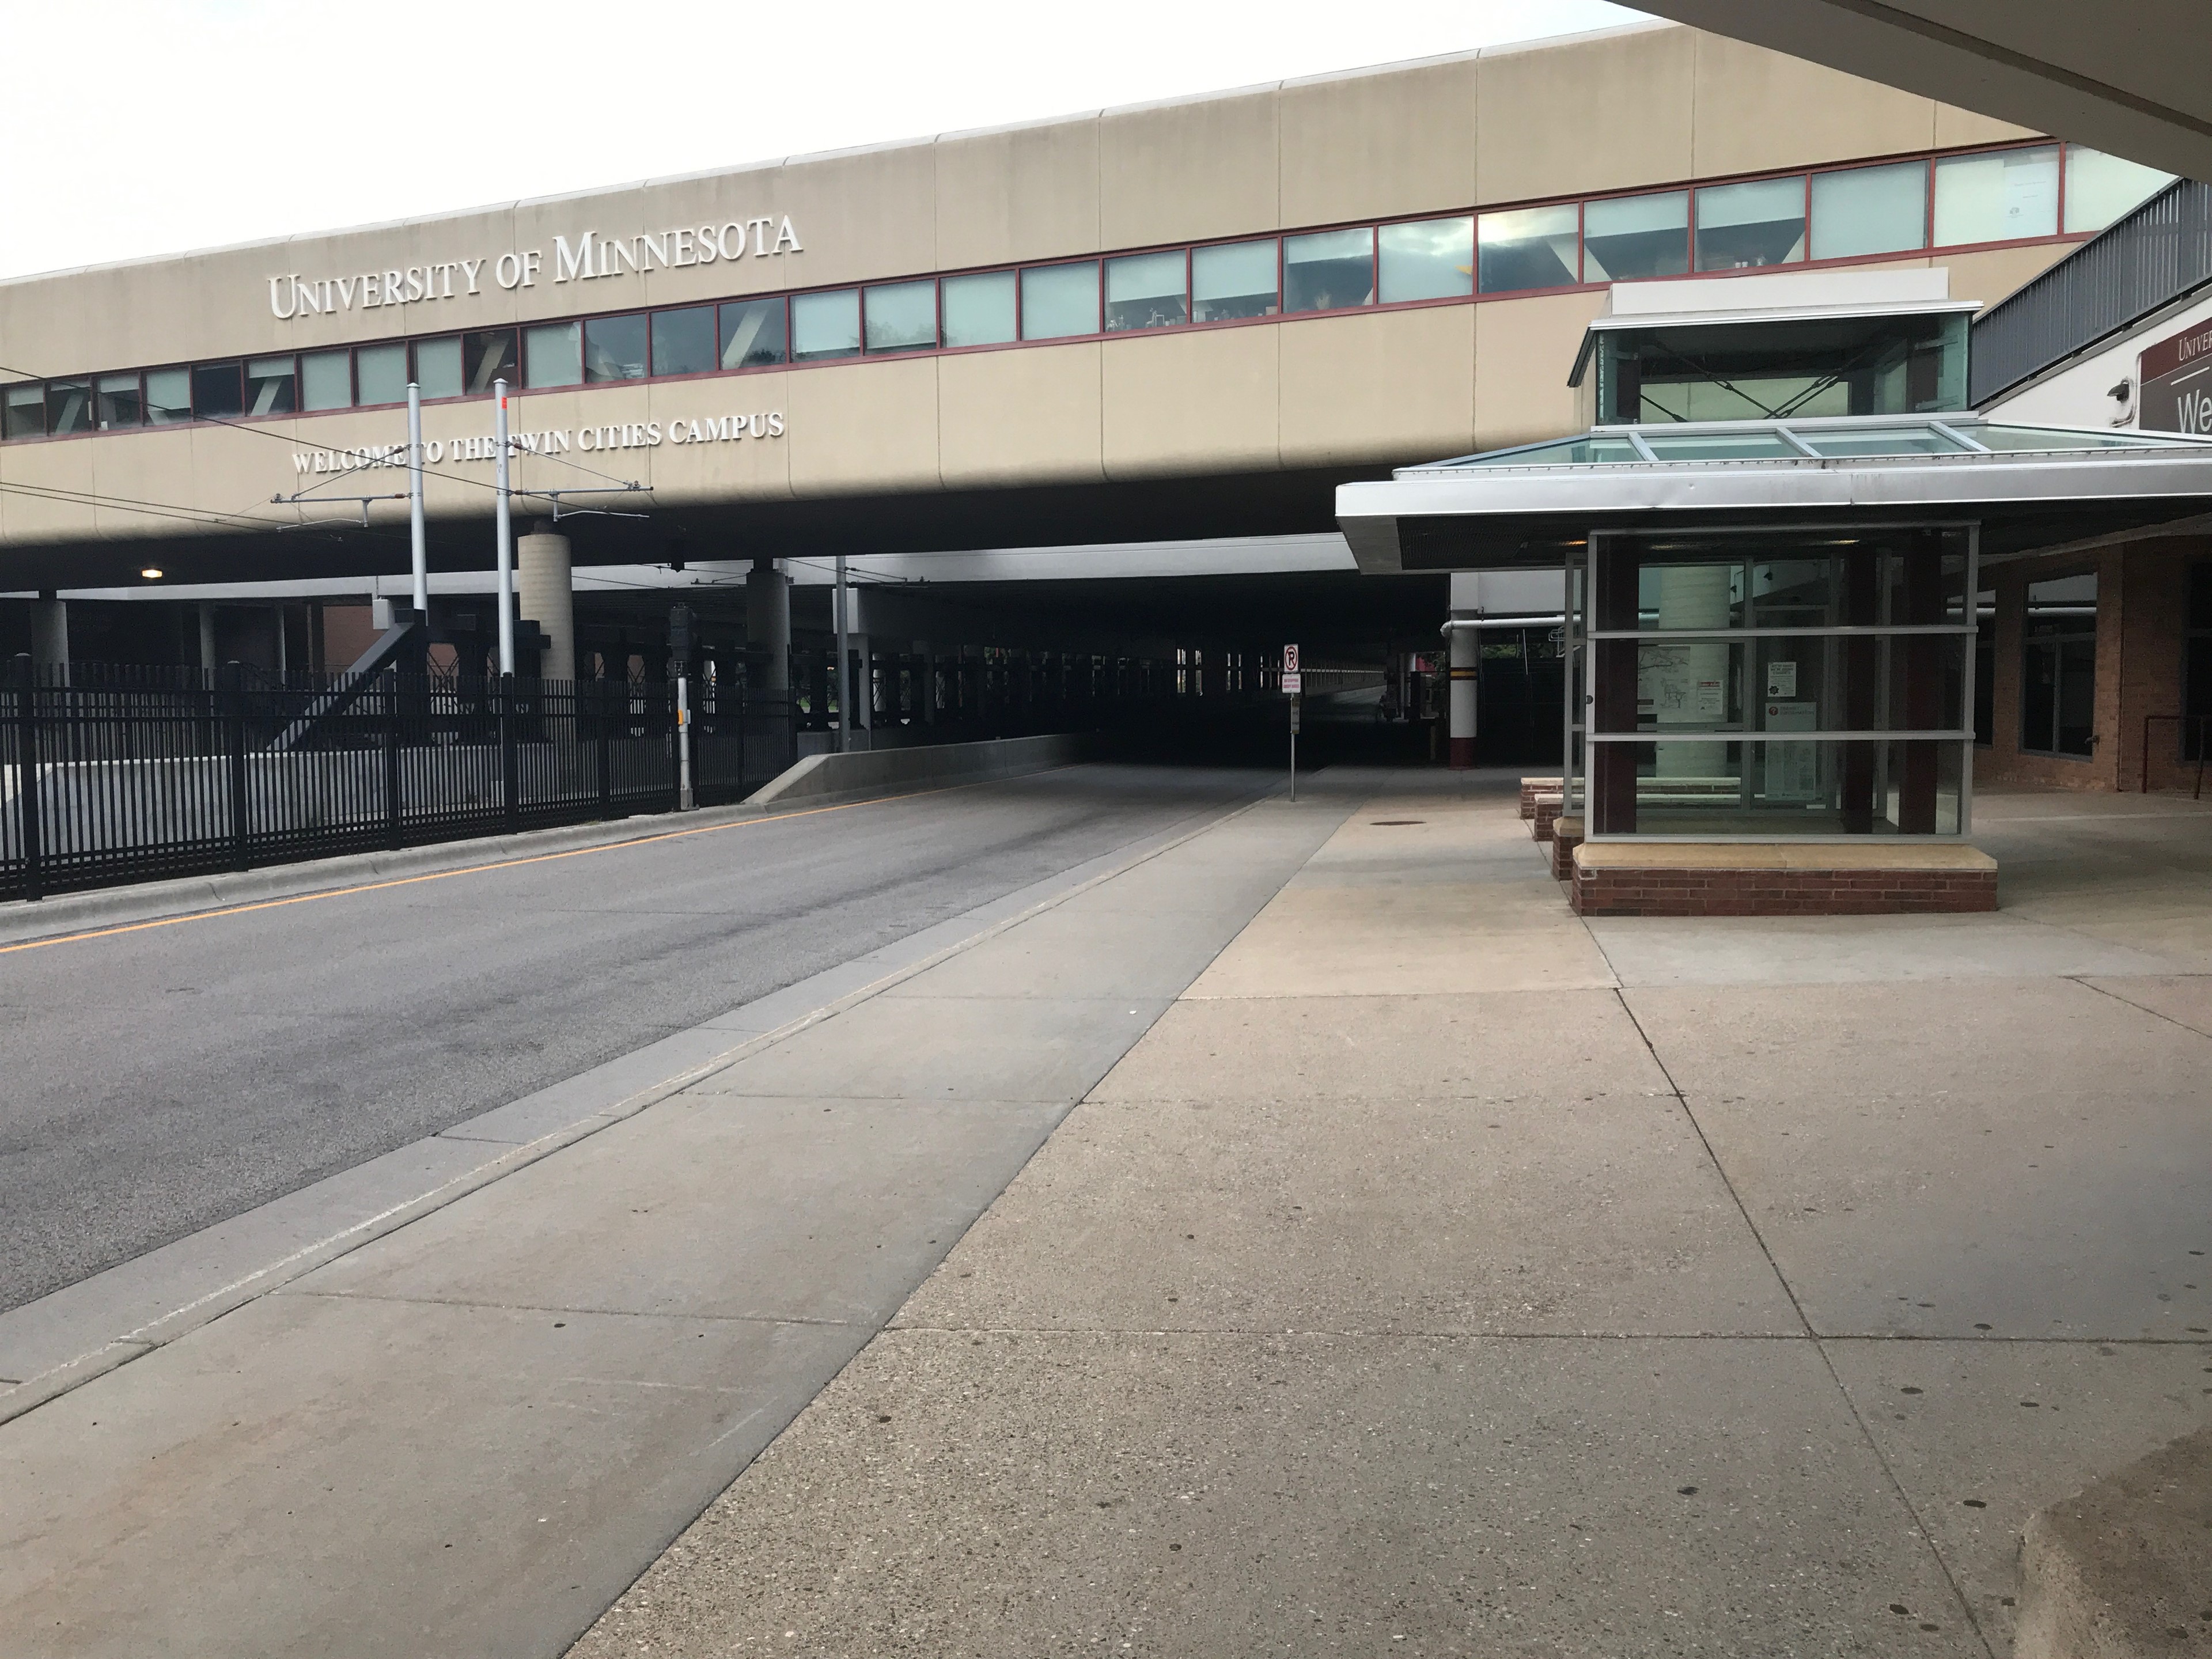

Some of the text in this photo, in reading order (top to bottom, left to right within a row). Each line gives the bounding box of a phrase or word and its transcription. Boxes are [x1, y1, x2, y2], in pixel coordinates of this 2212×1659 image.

[267, 215, 804, 319] UNIVERSITY OF MINNESOTA
[292, 412, 785, 474] WELCOME O THE TWIN CITIES CAMPUS
